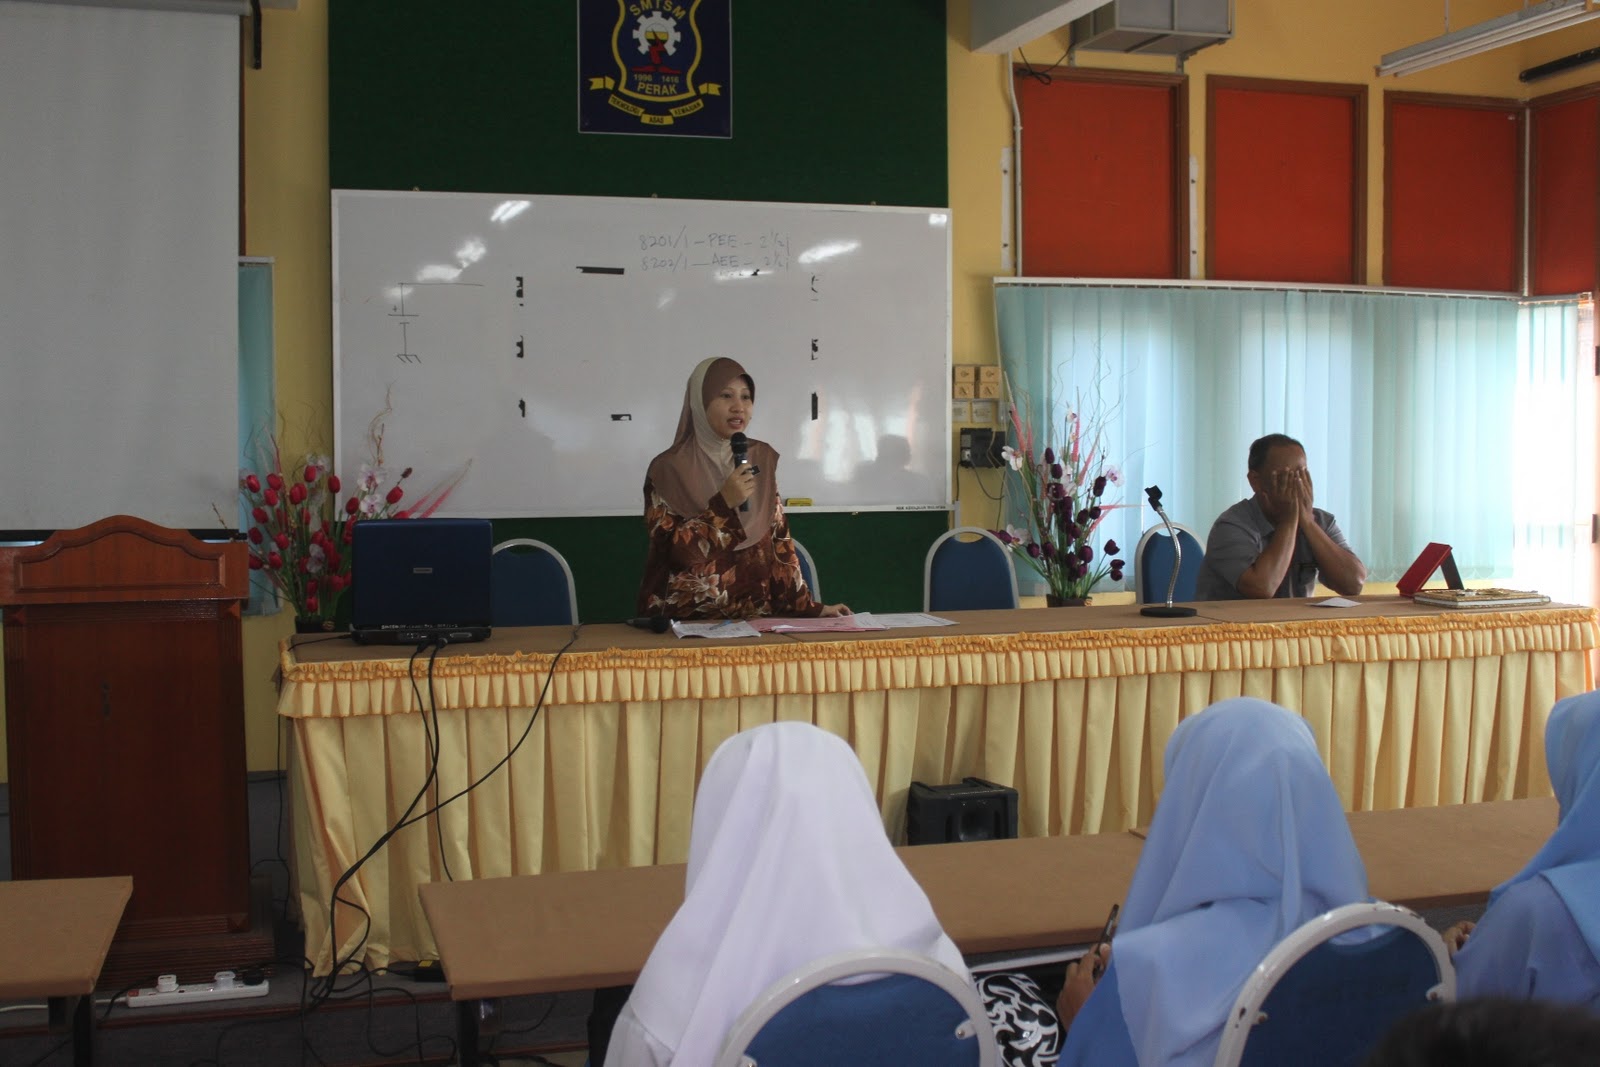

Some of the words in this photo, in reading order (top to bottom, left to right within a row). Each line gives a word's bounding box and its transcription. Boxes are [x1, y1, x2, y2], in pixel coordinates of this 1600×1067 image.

[637, 82, 678, 95] PERAK
[708, 232, 737, 248] PEE
[712, 252, 740, 268] AEE
